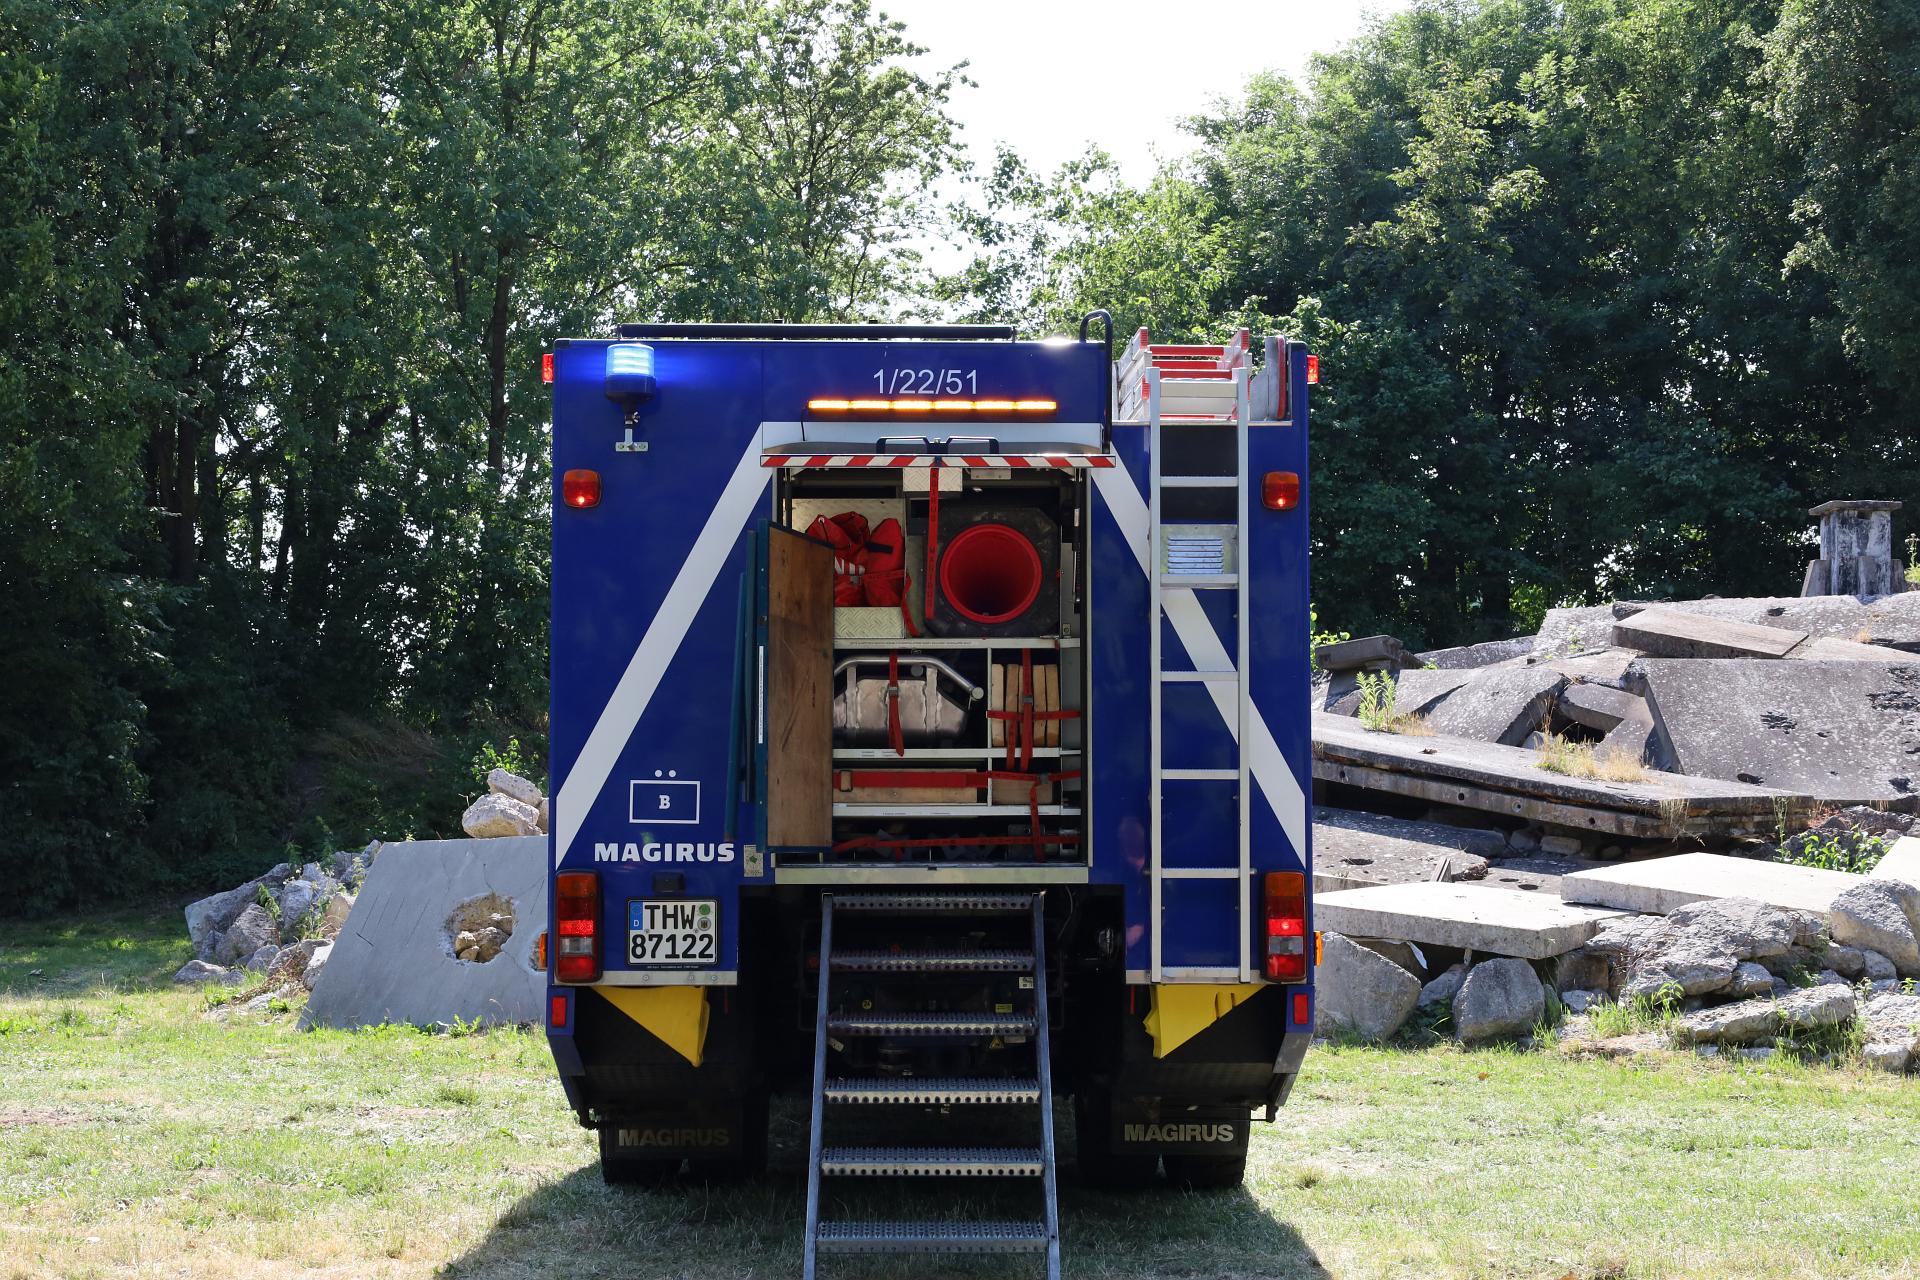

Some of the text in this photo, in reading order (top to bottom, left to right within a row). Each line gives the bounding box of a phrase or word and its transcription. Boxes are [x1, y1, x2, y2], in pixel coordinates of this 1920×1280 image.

[873, 368, 977, 395] 1/22/51
[658, 794, 671, 810] B
[594, 842, 735, 862] MAGIRUS
[633, 919, 640, 927] D
[644, 904, 696, 930] THW
[631, 933, 714, 959] 87122
[618, 1128, 730, 1147] MAGIRUS
[1124, 1123, 1234, 1142] MAGIRUS
